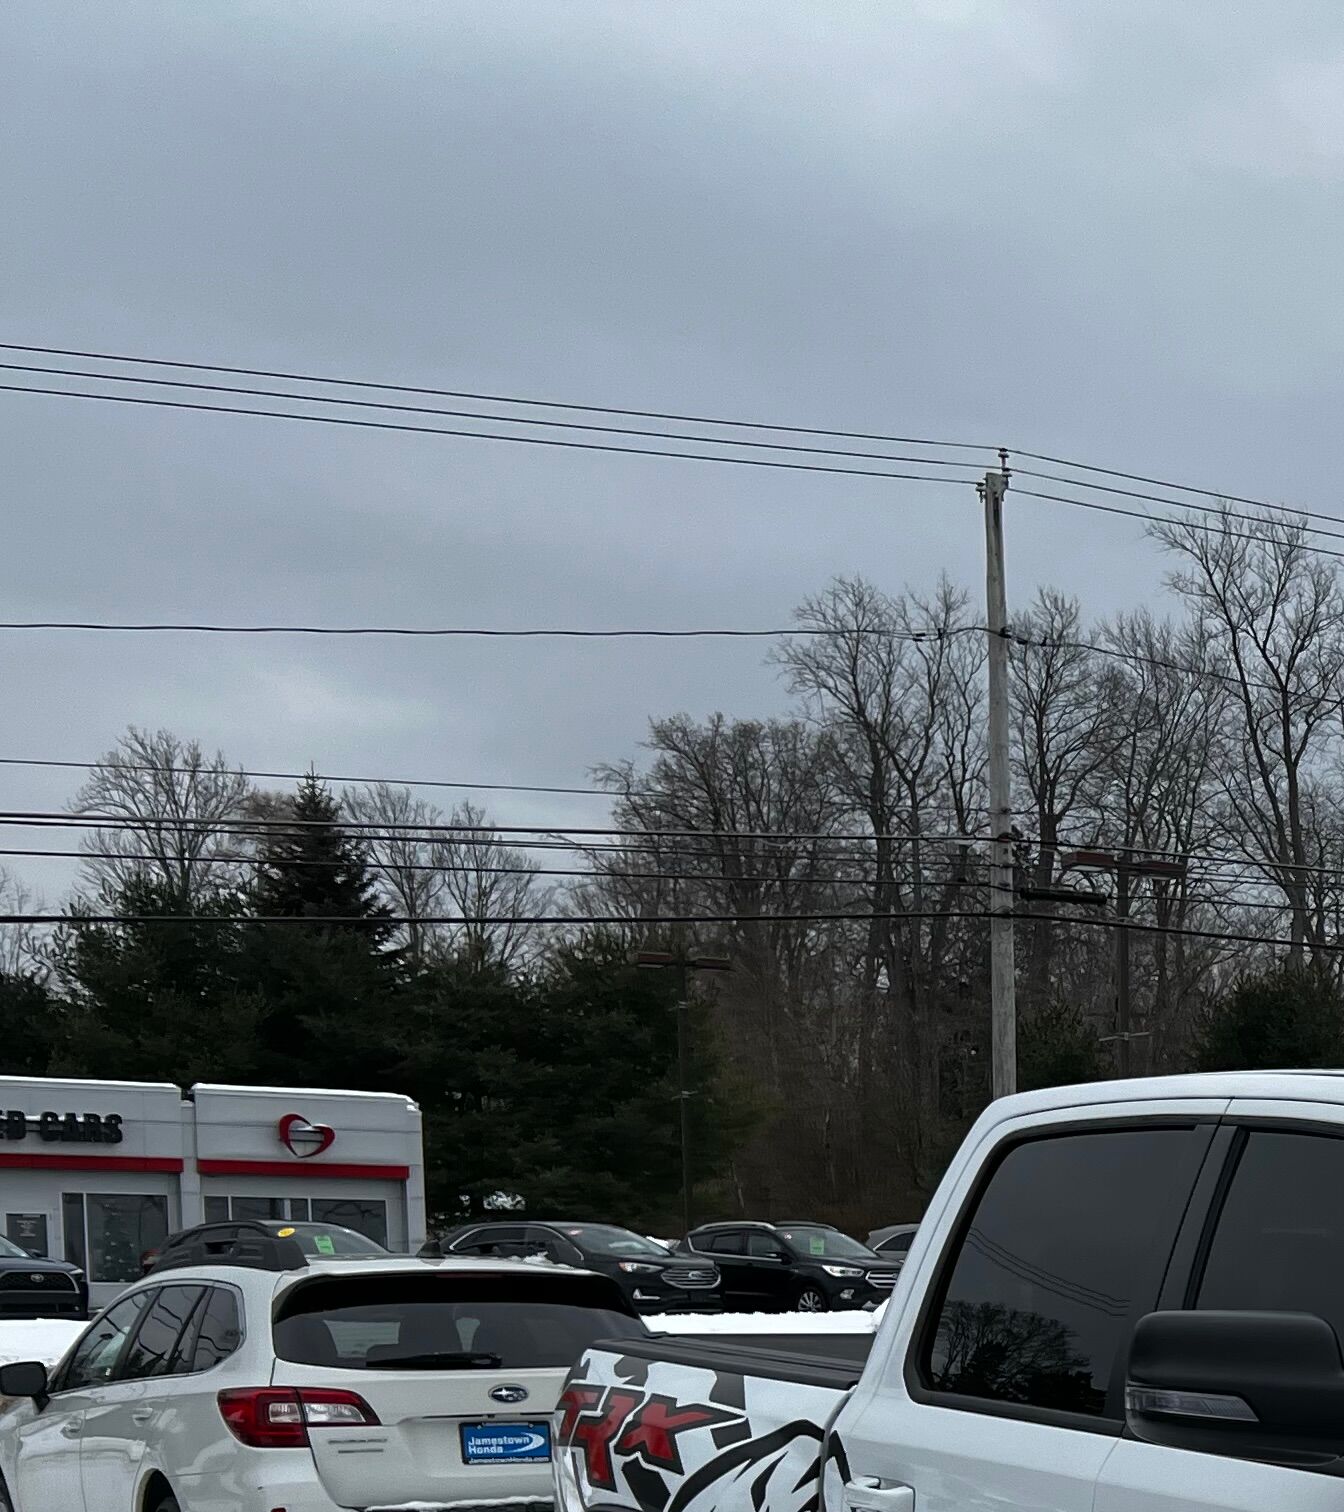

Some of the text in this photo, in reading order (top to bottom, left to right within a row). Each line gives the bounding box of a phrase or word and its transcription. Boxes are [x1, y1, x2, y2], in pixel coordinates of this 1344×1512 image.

[0, 1110, 123, 1143] D CARS
[468, 1436, 530, 1446] Jamestown
[468, 1446, 504, 1454] Honda
